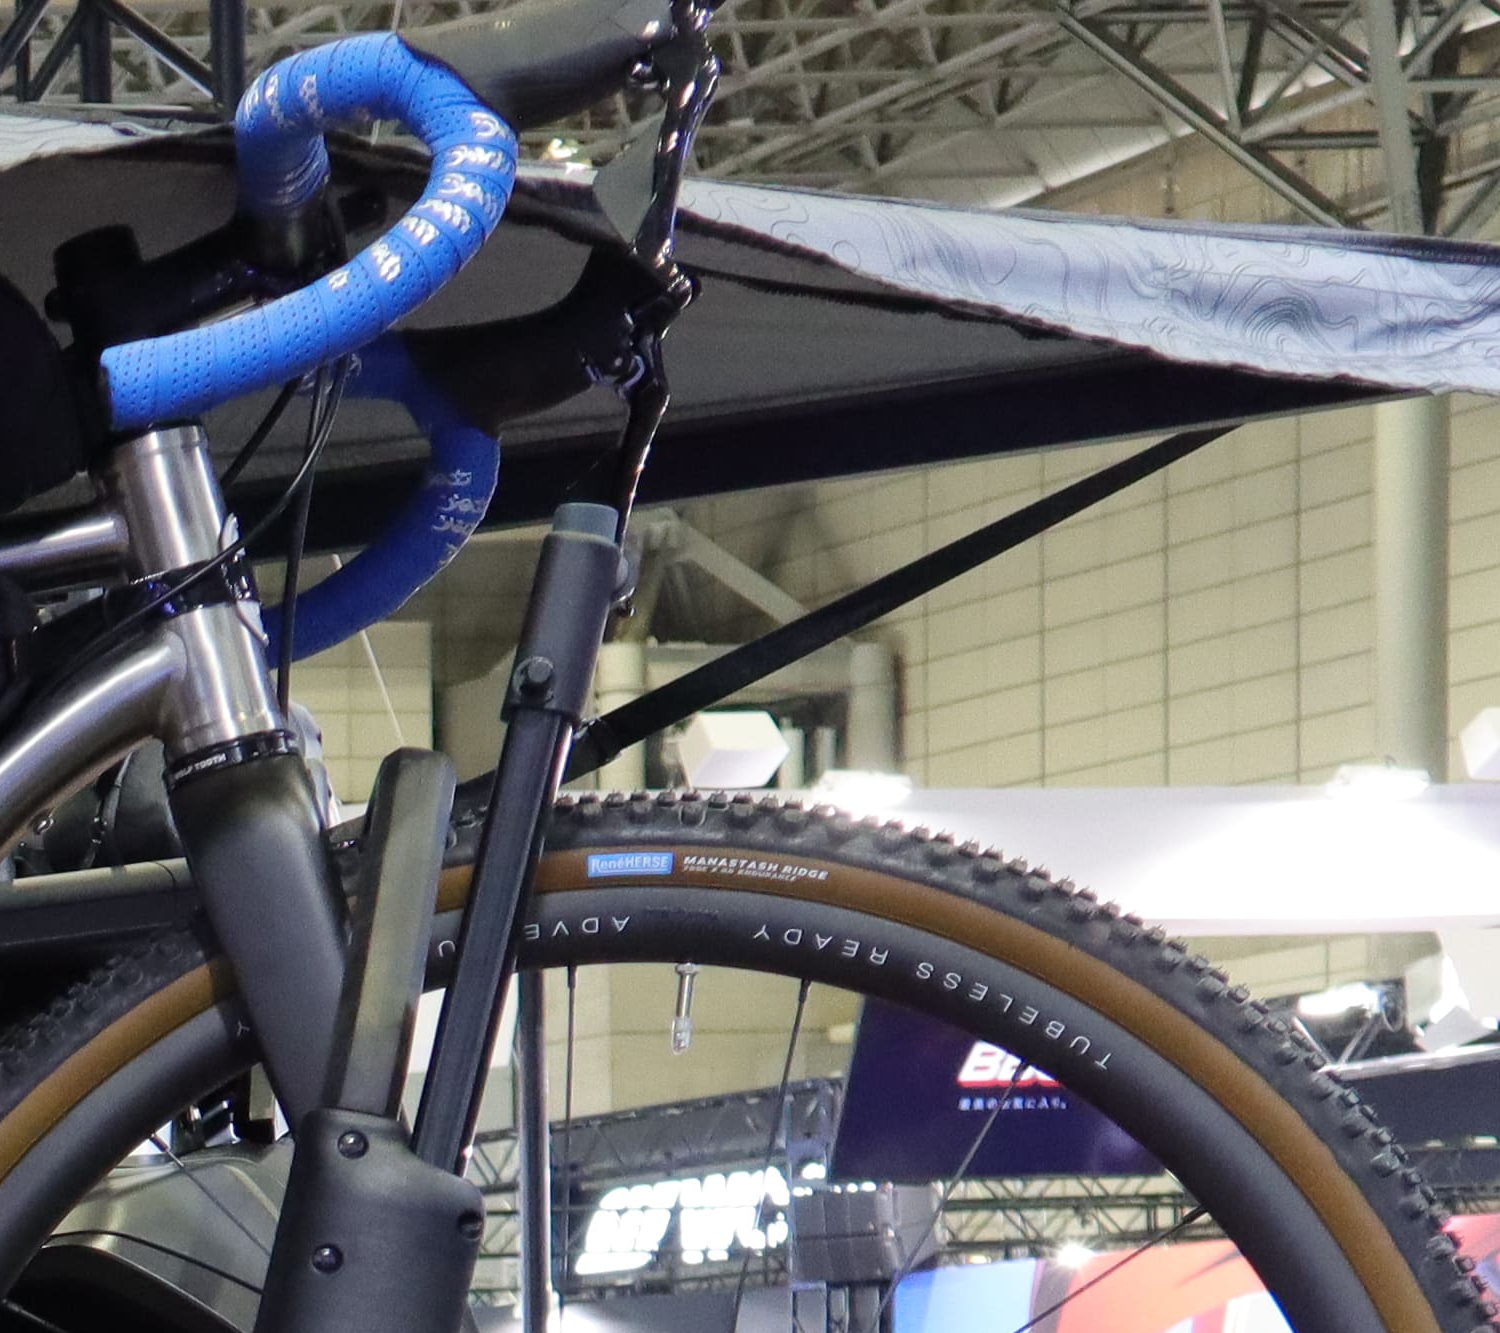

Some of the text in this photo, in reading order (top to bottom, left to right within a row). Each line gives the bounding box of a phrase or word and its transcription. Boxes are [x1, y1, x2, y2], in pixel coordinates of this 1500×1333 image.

[683, 856, 779, 873] MANASTASH
[782, 866, 829, 881] RIDGE
[752, 926, 891, 965] READY
[914, 961, 1113, 1071] TUBELESS
